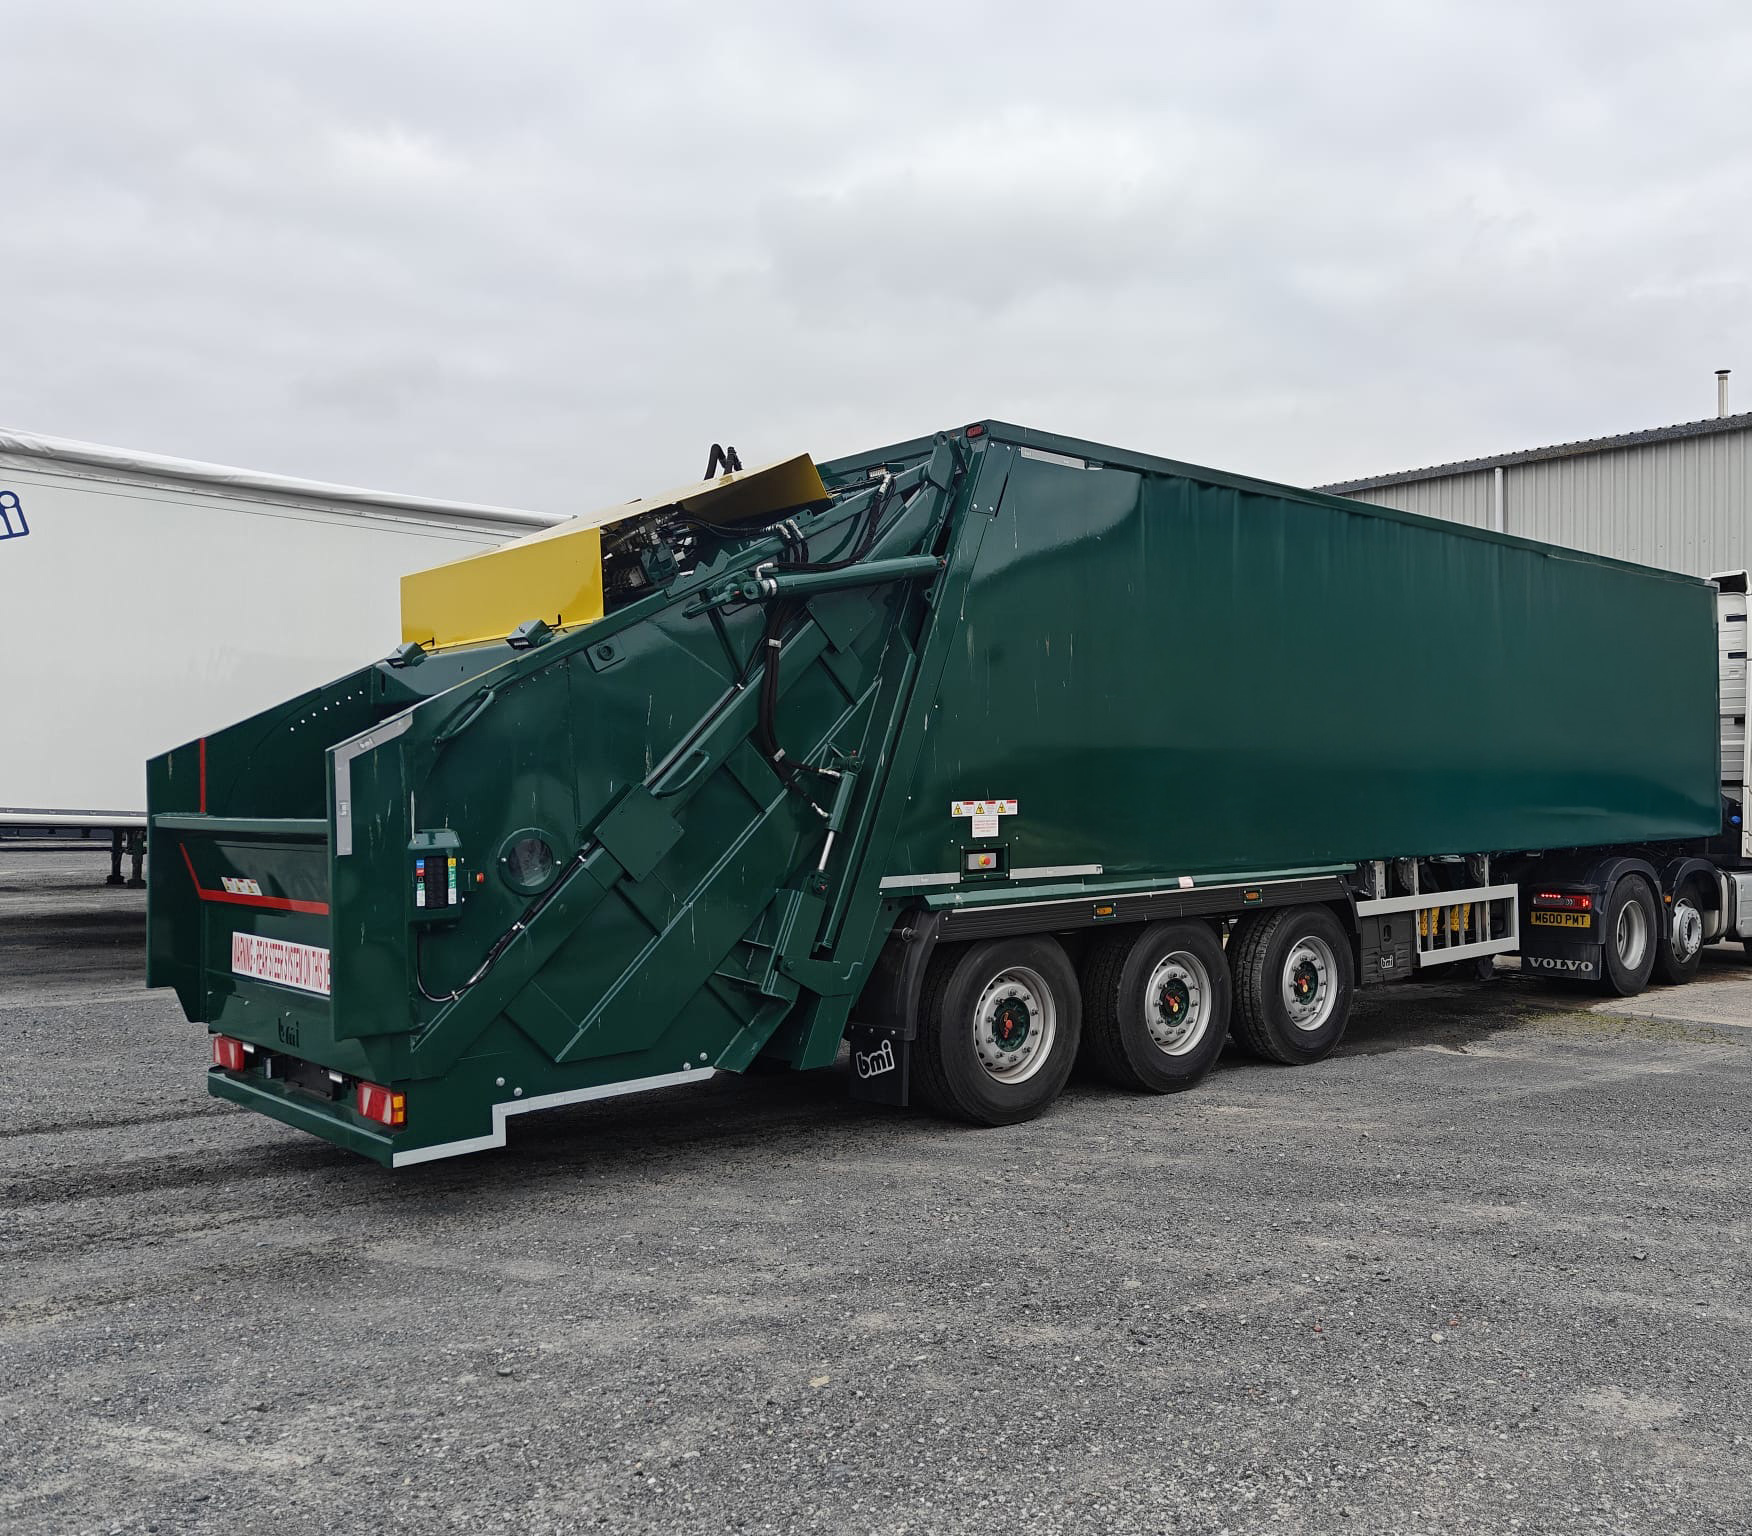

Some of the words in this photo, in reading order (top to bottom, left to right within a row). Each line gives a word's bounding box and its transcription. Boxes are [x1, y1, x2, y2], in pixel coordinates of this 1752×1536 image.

[1535, 912, 1562, 924] M600
[1565, 914, 1586, 925] PMT
[1528, 957, 1593, 971] VOLVO
[855, 1039, 895, 1079] bmi
